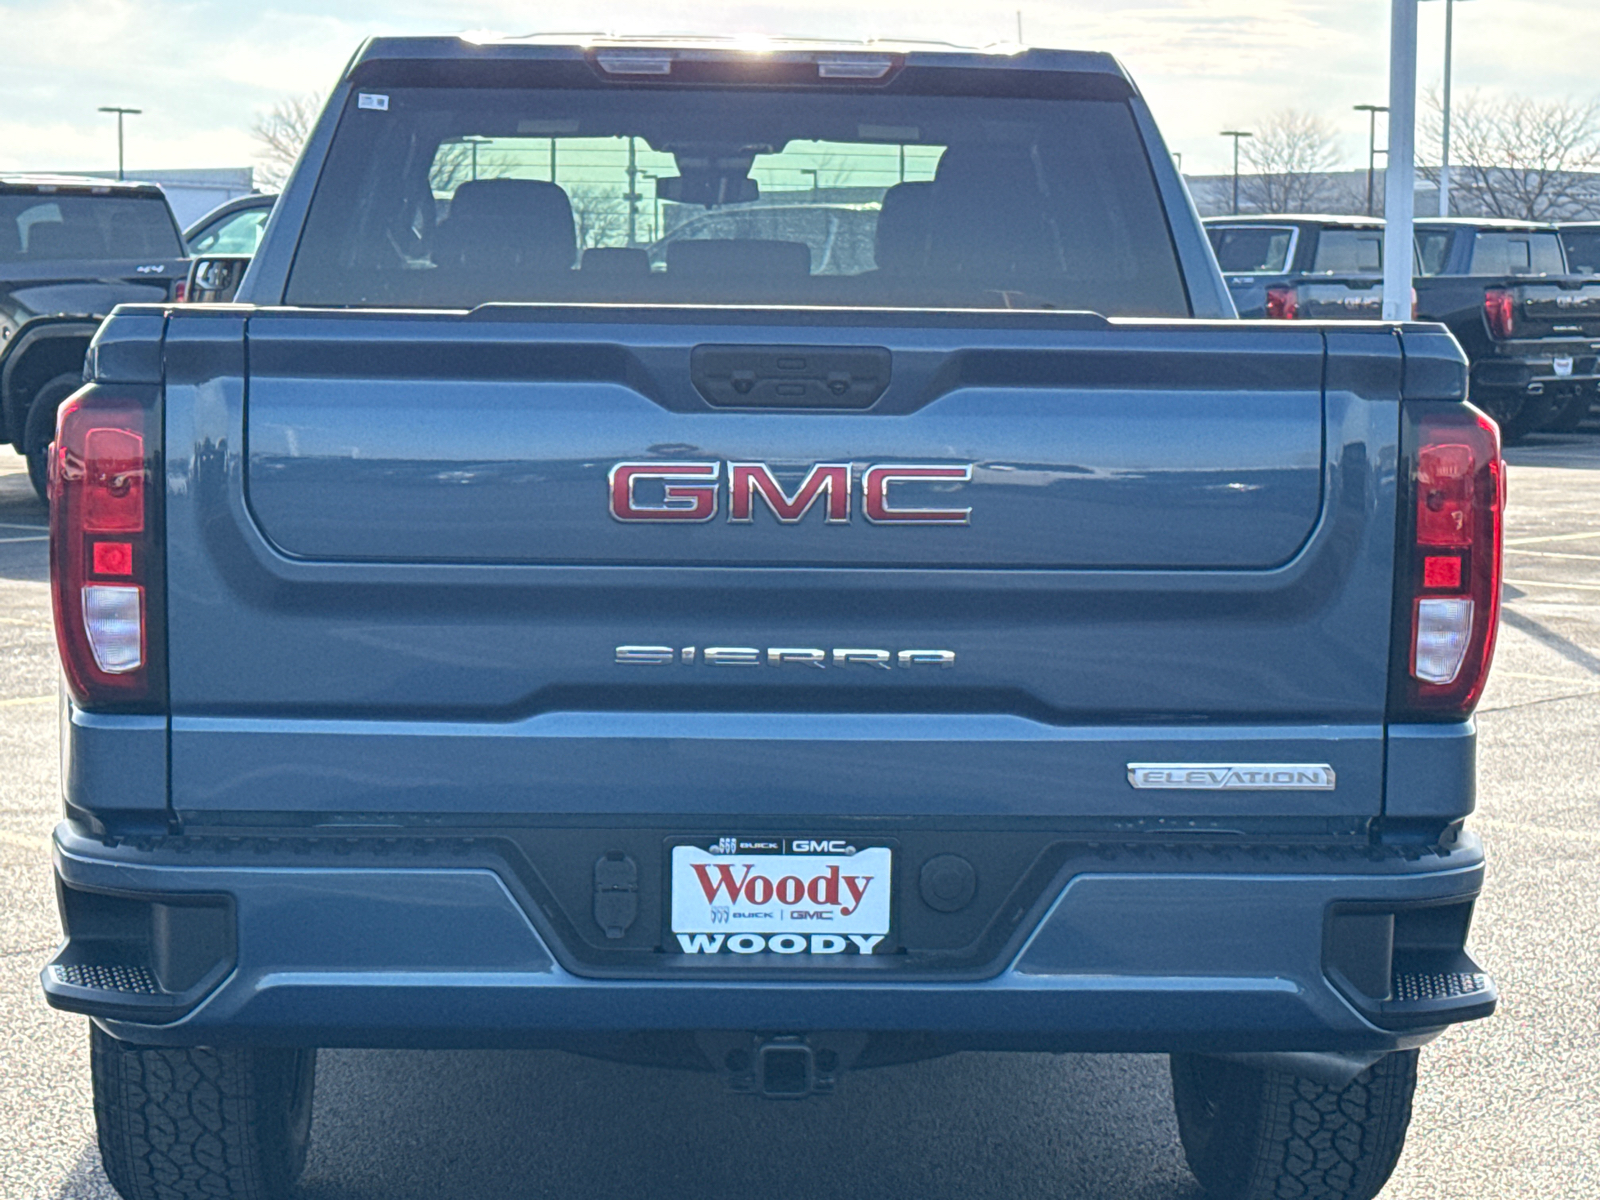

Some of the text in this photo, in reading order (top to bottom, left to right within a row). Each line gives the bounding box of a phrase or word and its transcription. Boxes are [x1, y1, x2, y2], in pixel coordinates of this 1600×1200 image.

[608, 461, 973, 525] GMC
[615, 646, 955, 669] SIERRA
[1143, 771, 1320, 785] ELEVATION
[792, 840, 847, 853] GMC
[690, 863, 874, 916] Woody
[732, 910, 833, 920] BUICK GMC
[676, 933, 885, 955] WOODY
